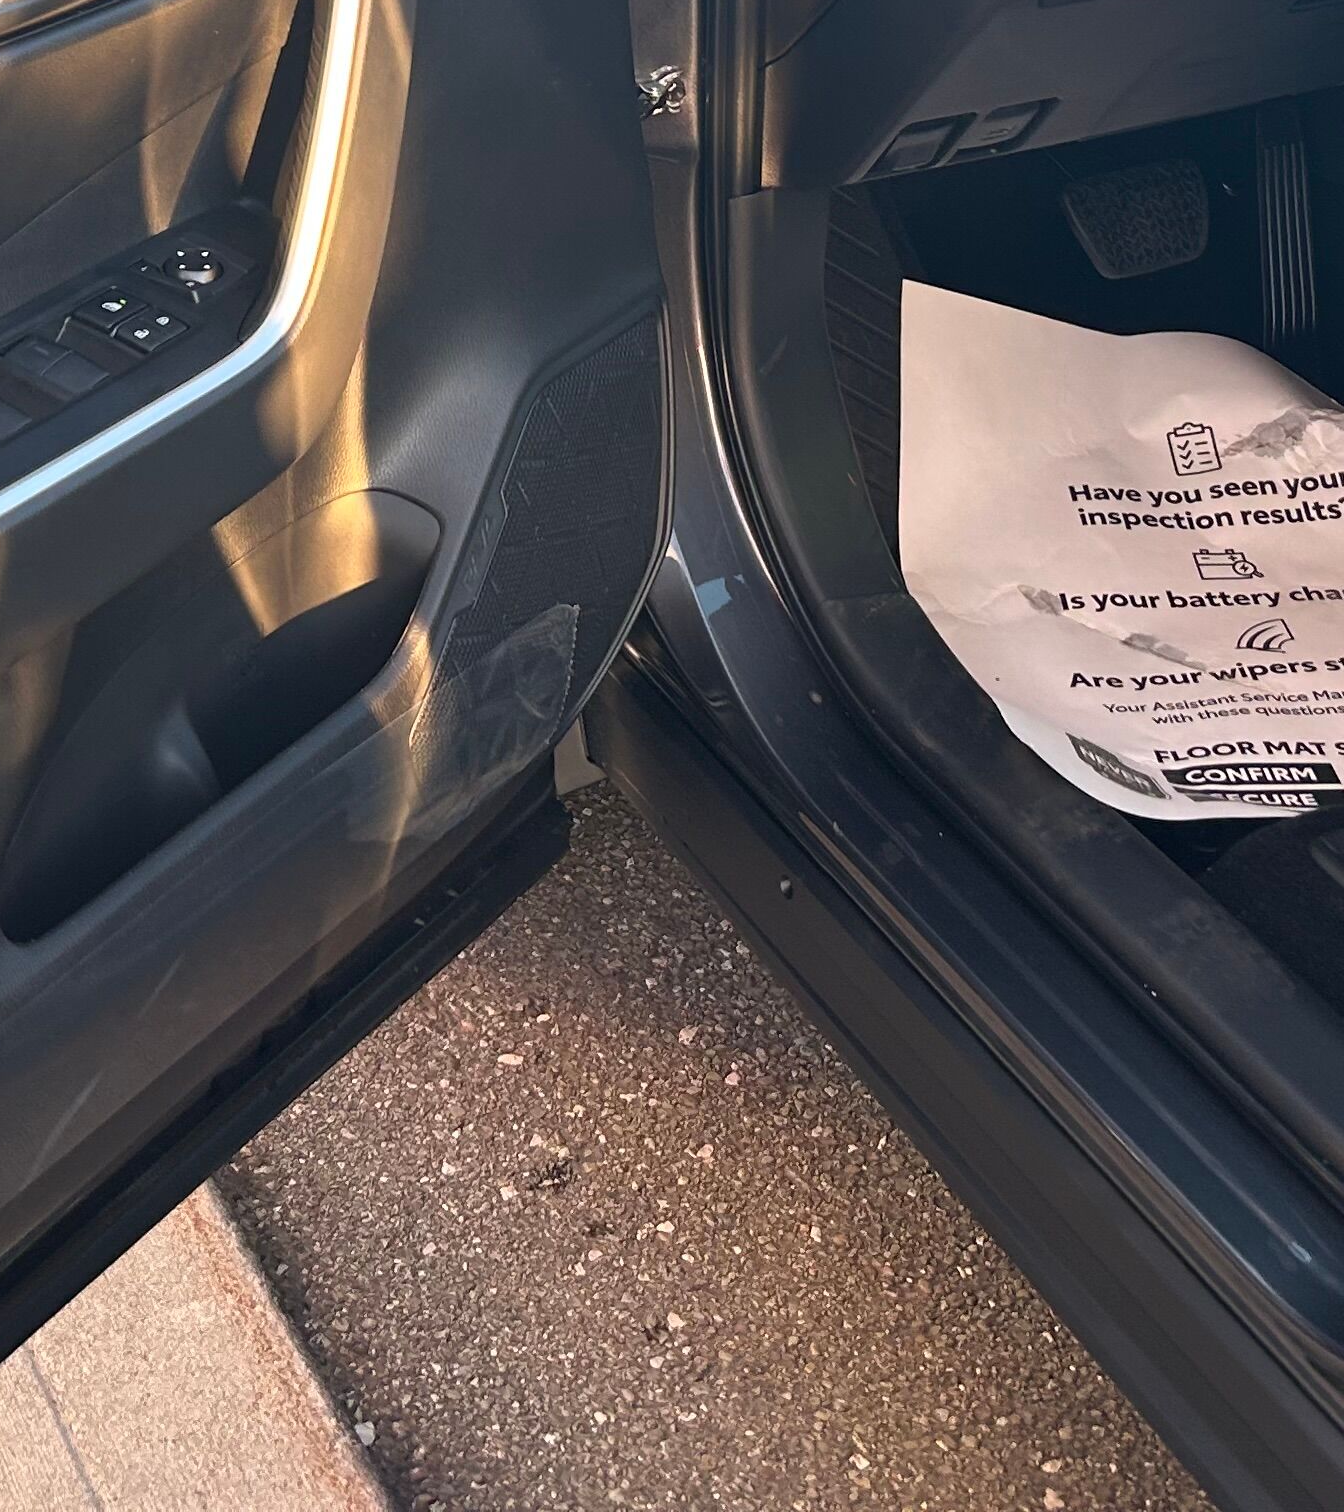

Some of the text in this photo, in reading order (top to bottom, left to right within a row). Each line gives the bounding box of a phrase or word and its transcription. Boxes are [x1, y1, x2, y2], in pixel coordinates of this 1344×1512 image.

[1068, 484, 1142, 502] Have
[1147, 489, 1203, 508] you
[1209, 479, 1278, 500] seen
[1077, 508, 1235, 531] inspection
[1059, 591, 1086, 611] Is
[1094, 592, 1162, 612] your
[1169, 590, 1281, 609] battery
[1069, 672, 1124, 689] Are
[1129, 670, 1202, 691] your
[1209, 658, 1318, 683] wipers
[1103, 702, 1147, 715] Your
[1152, 694, 1237, 712] Assistant
[1240, 691, 1309, 705] Service
[1152, 712, 1194, 726] with
[1198, 707, 1251, 720] these
[1153, 740, 1260, 764] FLOOR
[1263, 740, 1327, 756] MAT
[1184, 766, 1318, 784] CONFIRM
[1224, 792, 1319, 808] ECURE
